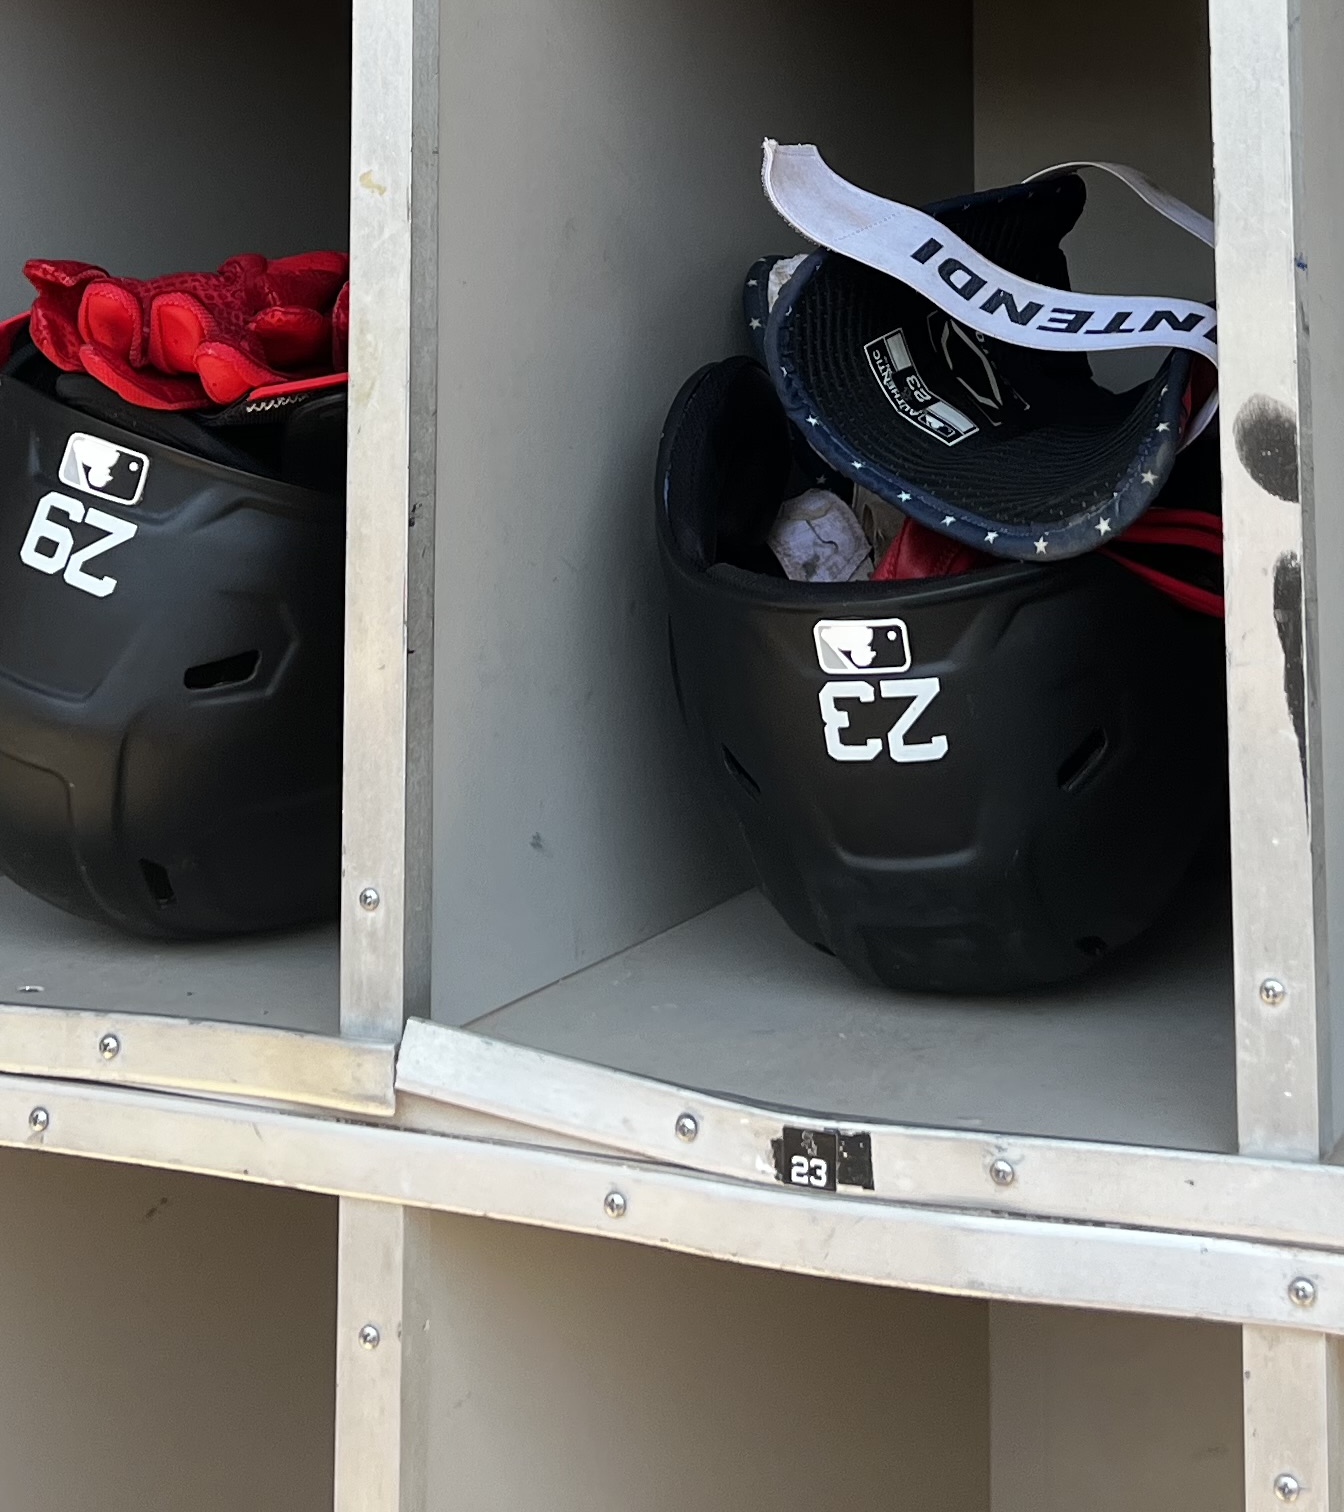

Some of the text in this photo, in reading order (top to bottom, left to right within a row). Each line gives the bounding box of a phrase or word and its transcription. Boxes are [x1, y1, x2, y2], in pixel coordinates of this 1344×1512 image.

[872, 348, 924, 417] AUTHENTIC
[906, 374, 932, 403] 23
[20, 491, 138, 598] 29
[819, 677, 948, 762] 23
[791, 1155, 827, 1188] 23
